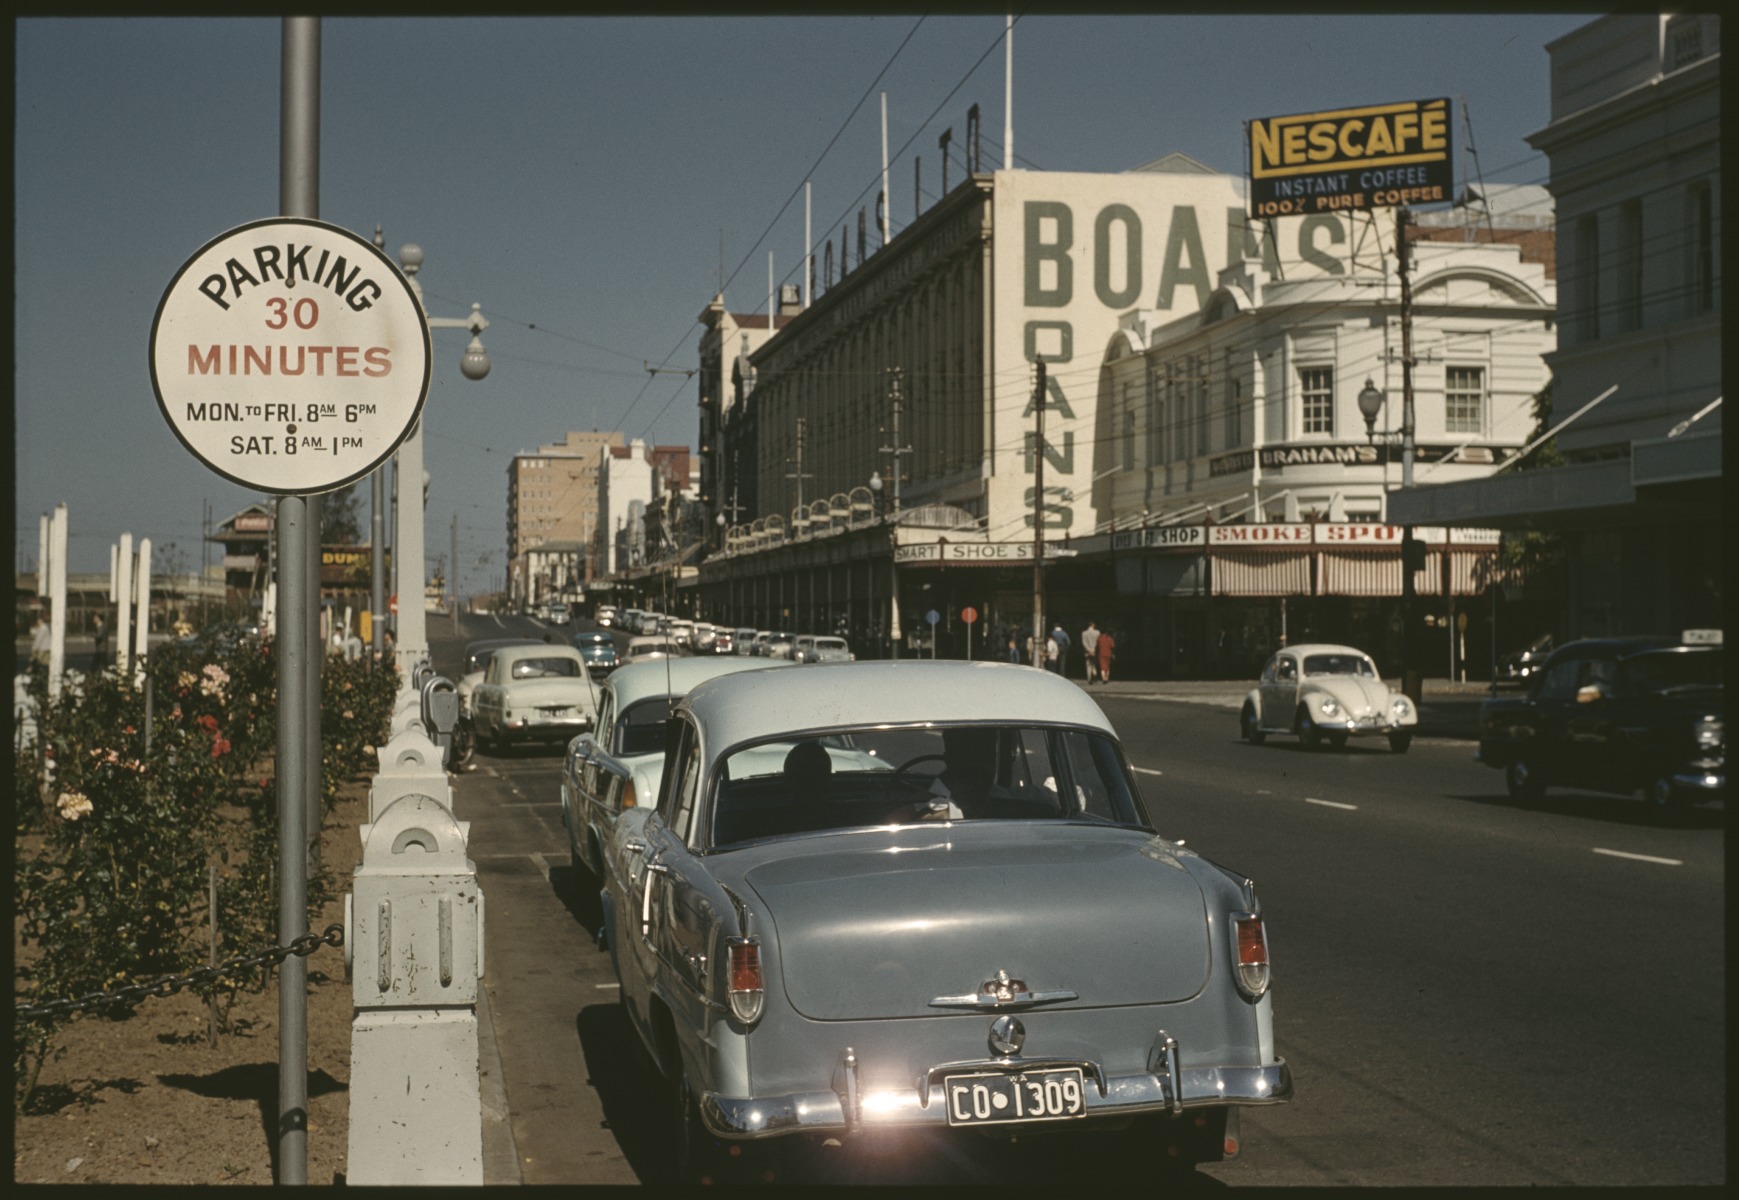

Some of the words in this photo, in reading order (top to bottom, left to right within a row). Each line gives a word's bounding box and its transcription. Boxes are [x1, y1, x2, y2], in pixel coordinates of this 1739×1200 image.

[1251, 99, 1446, 179] NESCAFÉ
[1274, 174, 1349, 197] INSTANT
[1360, 167, 1427, 189] COFFEE
[1317, 193, 1365, 210] PURE
[1373, 186, 1443, 206] COFFEE
[198, 243, 382, 312] PARKING
[265, 297, 319, 330] 30
[187, 344, 393, 378] MINUTES
[186, 403, 244, 422] MON.
[264, 403, 302, 422] FRI.
[230, 436, 277, 455] SAT.
[1161, 529, 1199, 543] SHOP
[1215, 526, 1311, 541] SMOKE
[896, 545, 937, 561] SMART
[953, 543, 1008, 559] SHOE
